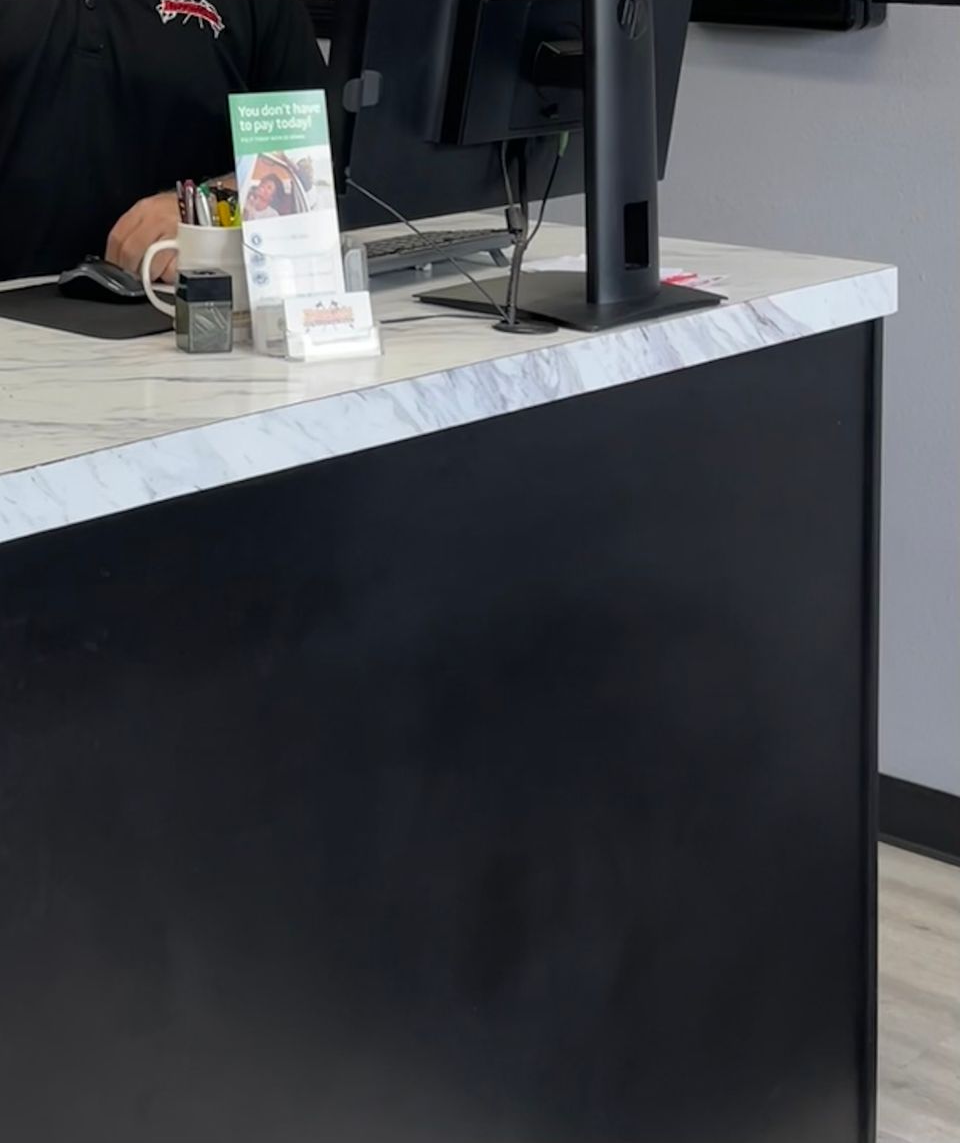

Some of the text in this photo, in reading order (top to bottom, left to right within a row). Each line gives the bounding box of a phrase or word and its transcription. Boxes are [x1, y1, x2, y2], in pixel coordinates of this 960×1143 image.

[238, 102, 321, 118] You don't have
[239, 115, 312, 134] to pay today!
